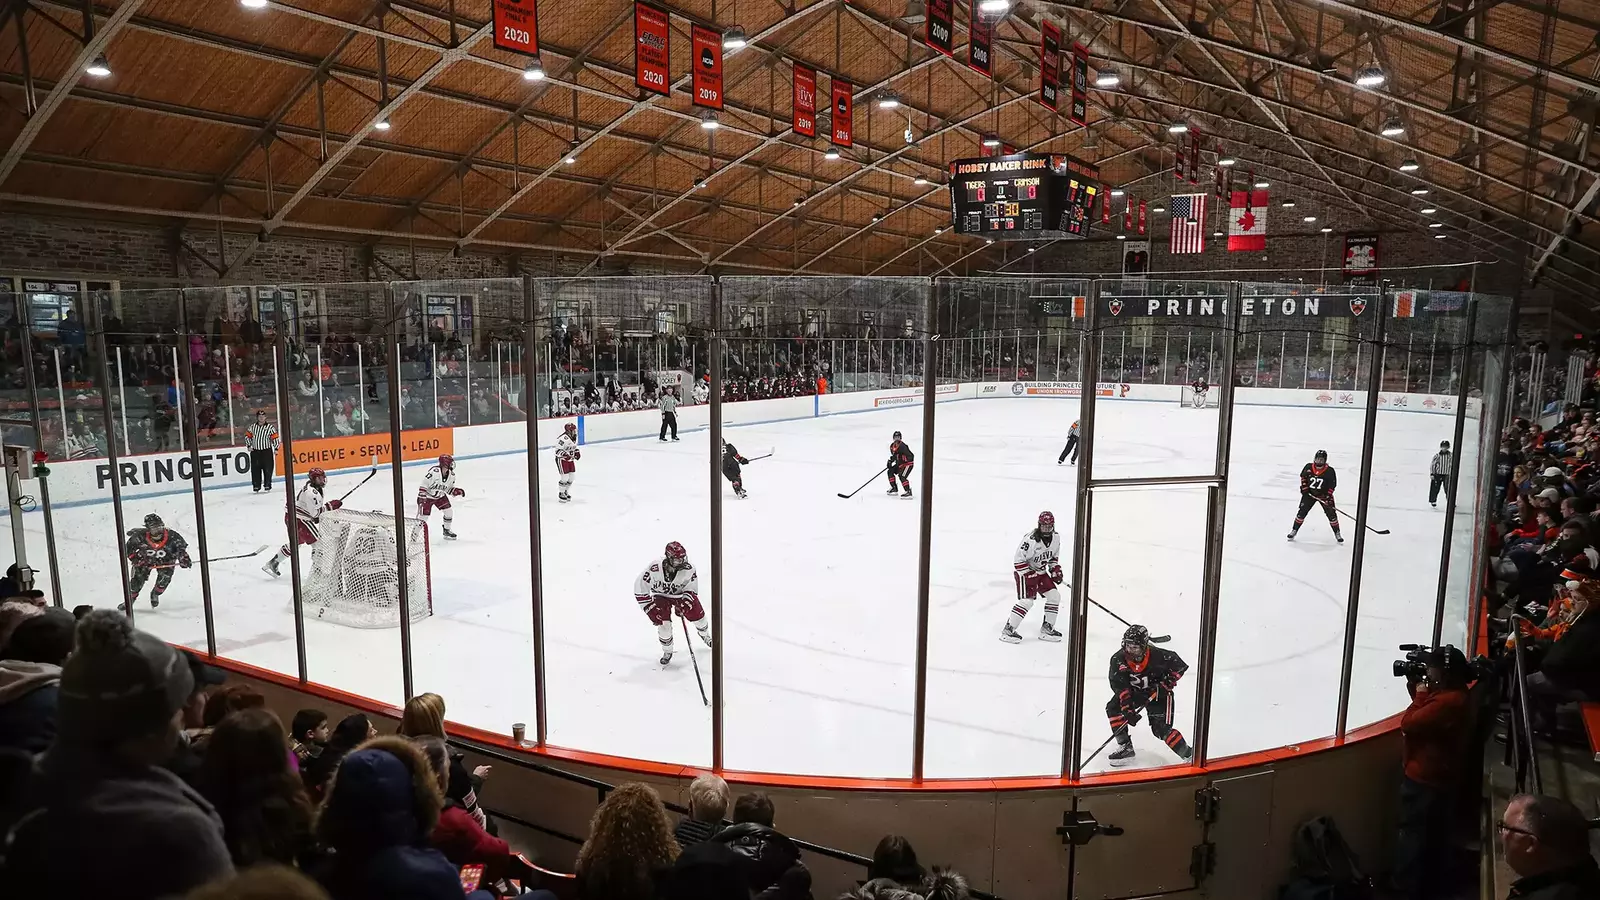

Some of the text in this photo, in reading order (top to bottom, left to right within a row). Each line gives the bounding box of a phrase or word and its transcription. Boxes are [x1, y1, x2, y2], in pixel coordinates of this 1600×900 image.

[504, 26, 530, 45] 2020
[932, 22, 949, 43] 2009
[643, 69, 664, 86] 2020
[699, 87, 717, 101] 2019
[798, 117, 812, 130] 2019
[836, 129, 849, 141] 2016
[958, 158, 1046, 174] HOBEY BAKER RINK
[965, 180, 986, 190] TIGERS
[1013, 177, 1040, 187] CRIMSON
[291, 438, 440, 464] ACHIEVE SERV LEAD
[95, 451, 251, 489] PRINCETO
[1308, 476, 1325, 490] 27
[1129, 673, 1149, 690] 21
